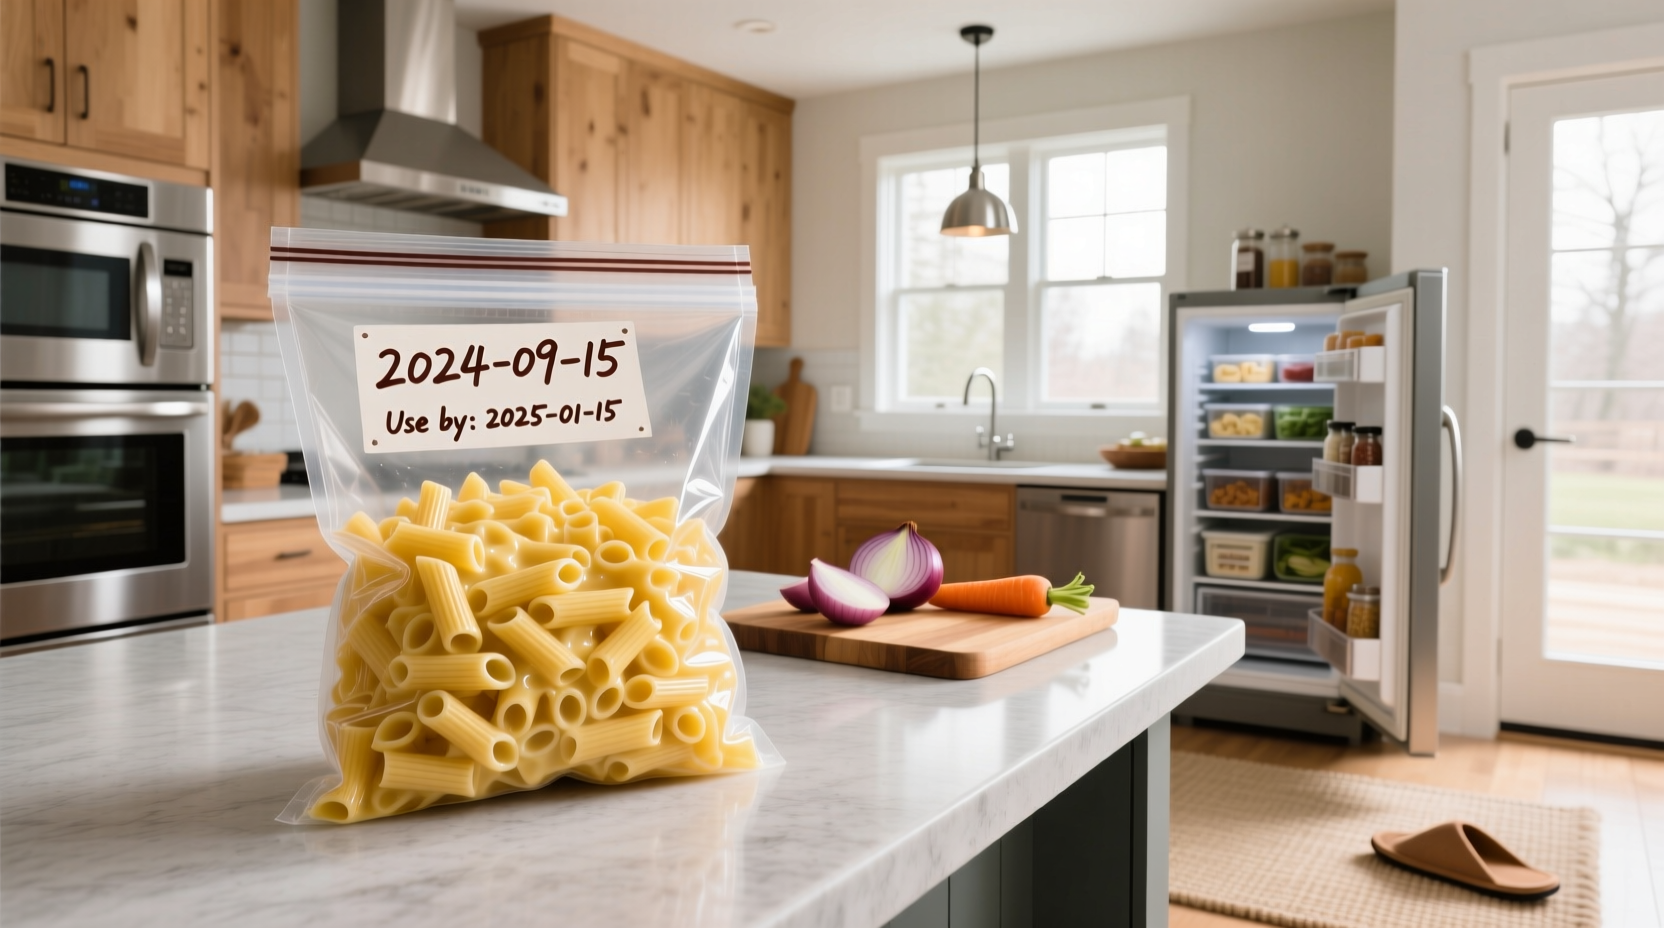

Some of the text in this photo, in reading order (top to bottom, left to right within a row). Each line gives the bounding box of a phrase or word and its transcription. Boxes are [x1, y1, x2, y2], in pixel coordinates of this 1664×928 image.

[375, 338, 626, 390] 2024-09-15
[385, 398, 623, 443] Use by: 2025-01-15
